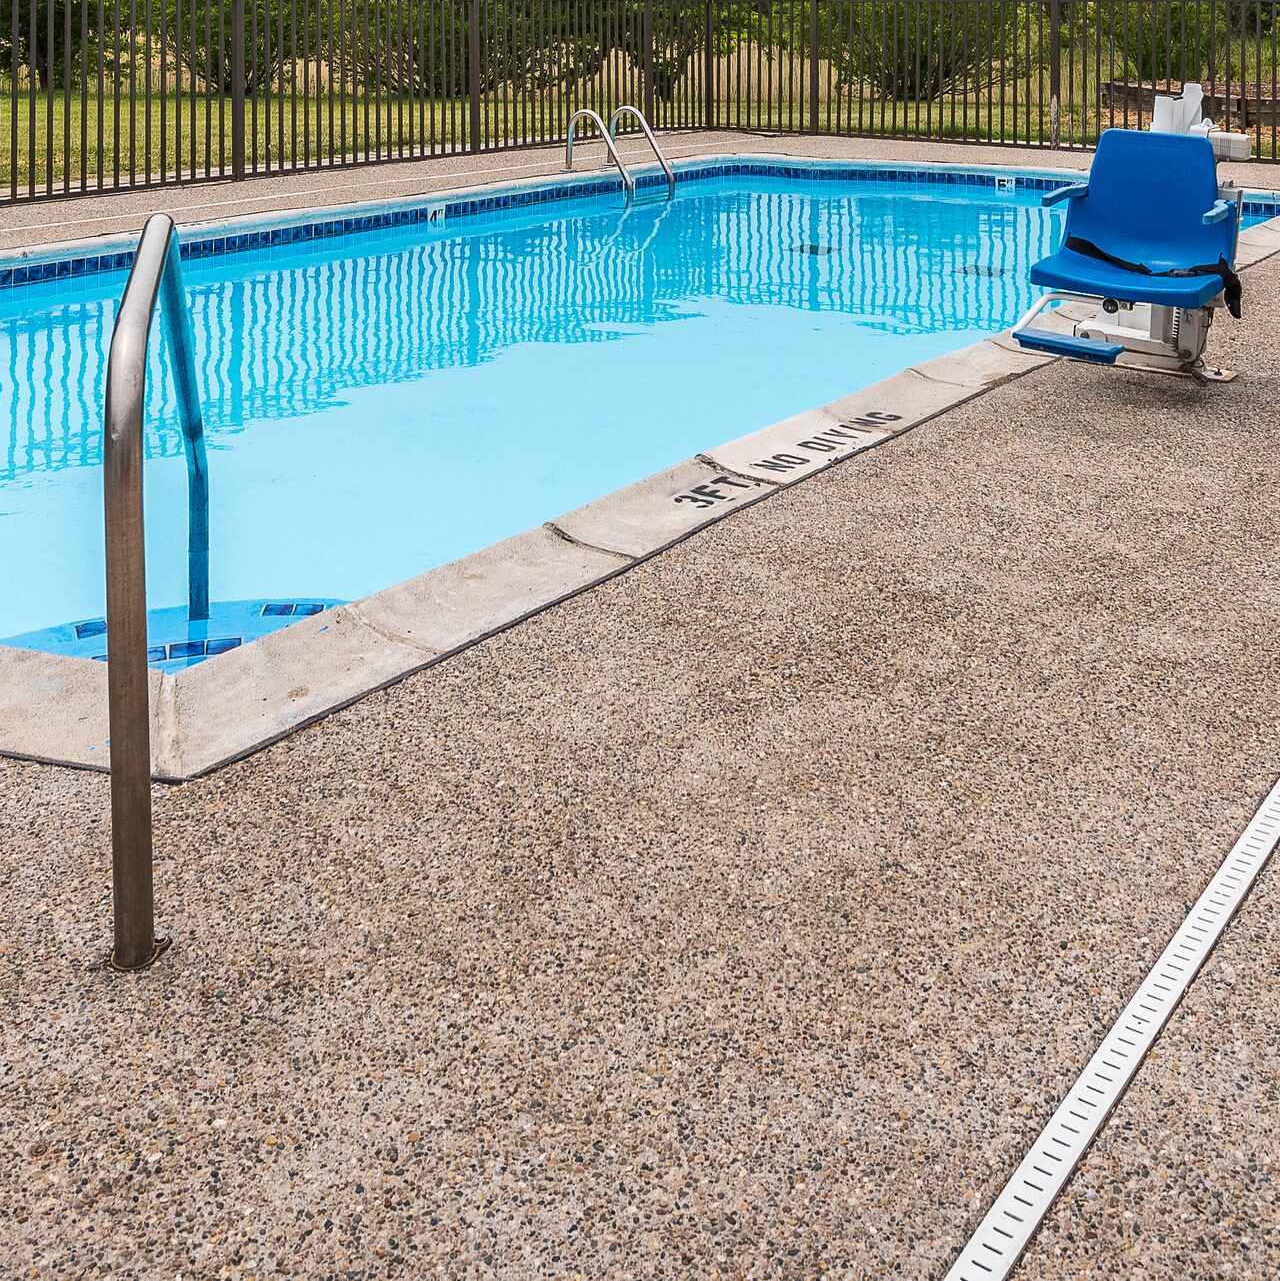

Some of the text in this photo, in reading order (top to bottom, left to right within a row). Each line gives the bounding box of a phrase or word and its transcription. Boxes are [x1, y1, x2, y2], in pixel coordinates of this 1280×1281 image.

[674, 412, 903, 508] 3FT NO DIVING
